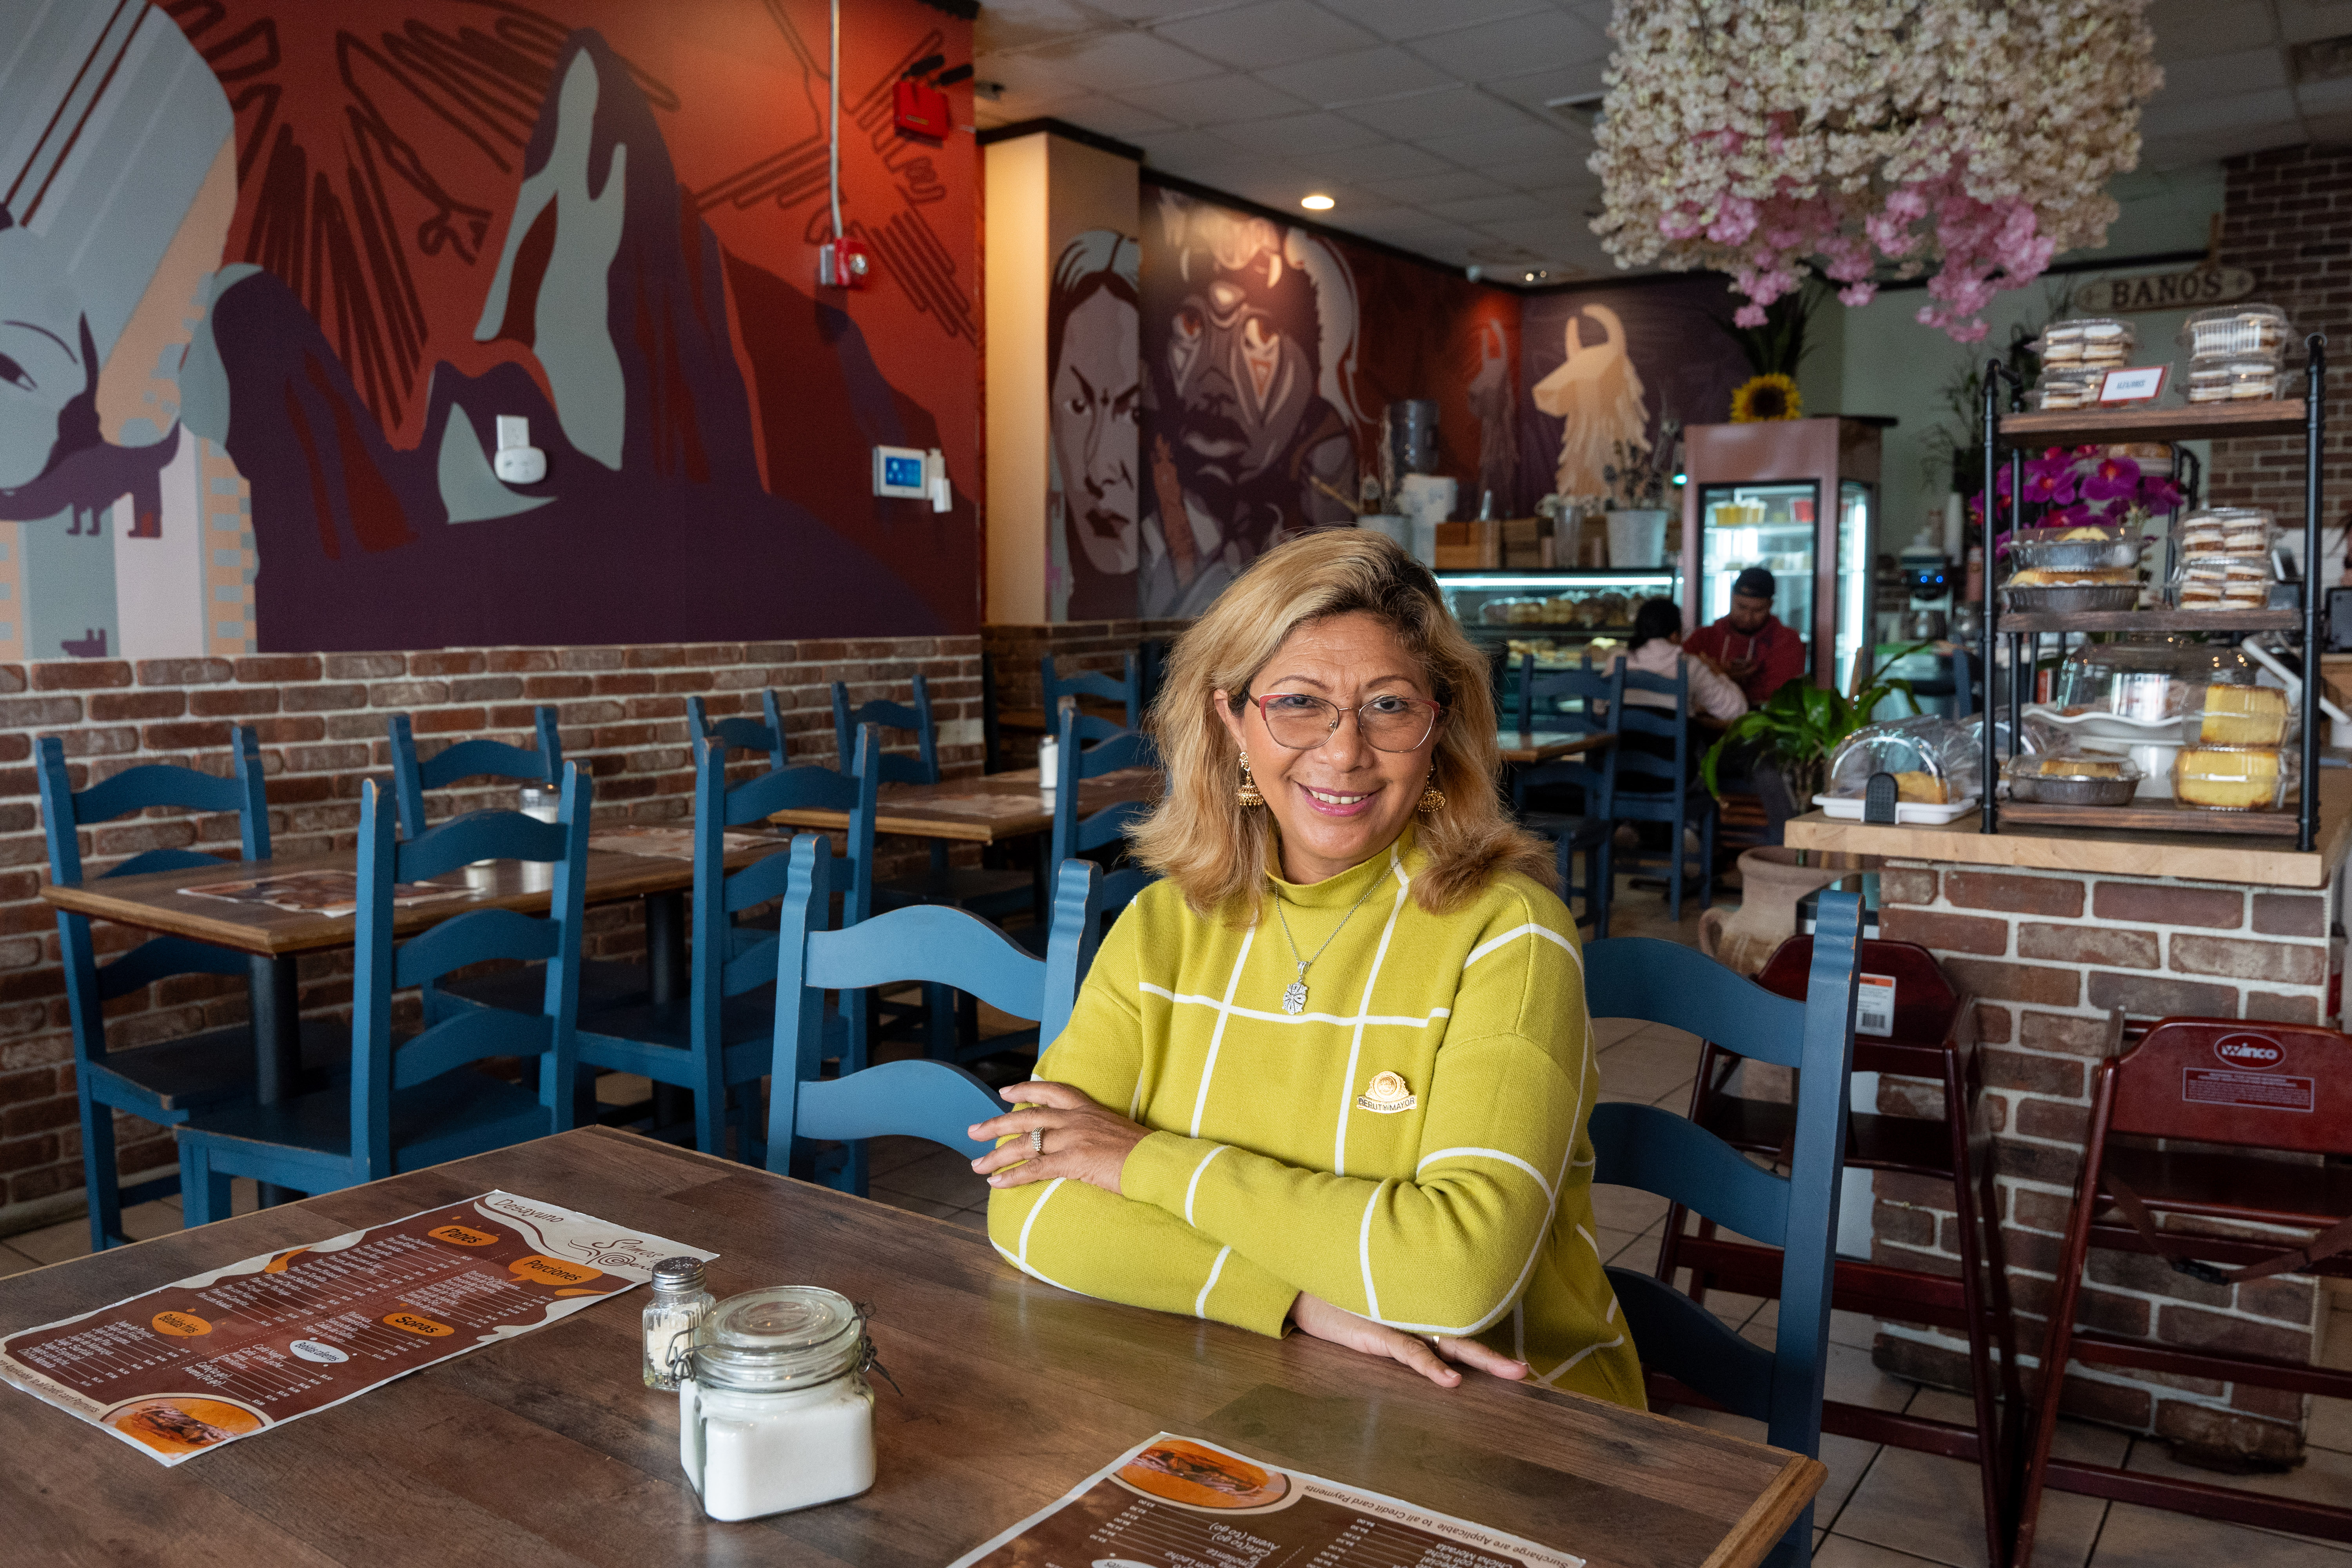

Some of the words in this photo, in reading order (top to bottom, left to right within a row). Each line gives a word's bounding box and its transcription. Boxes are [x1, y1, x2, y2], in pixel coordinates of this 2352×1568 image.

[2221, 1042, 2278, 1060] winco
[1359, 1098, 1387, 1111] DEPUTY
[1390, 1097, 1415, 1111] MAYOR
[494, 1199, 563, 1222] Desayuno
[440, 1228, 482, 1243] Panes
[592, 1239, 664, 1258] Somos
[523, 1259, 581, 1281] Porciones
[158, 1314, 185, 1327] Bebidas
[395, 1316, 438, 1333] Sopas
[55, 1347, 84, 1361] Especial
[69, 1344, 94, 1356] Surtido
[229, 1351, 248, 1361] Avena
[265, 1349, 287, 1359] Negro
[294, 1342, 318, 1352] Bebidas
[314, 1350, 339, 1361] calientes
[33, 1356, 56, 1368] Morada
[217, 1354, 247, 1369] Emoliente
[263, 1357, 283, 1368] Leche
[181, 1366, 206, 1377] Avena
[5, 1364, 33, 1381] Applicable
[42, 1385, 63, 1395] Credit
[69, 1398, 99, 1413] Payments
[1304, 1485, 1350, 1502] Payments
[1350, 1498, 1374, 1508] card
[1375, 1505, 1405, 1519] Credit
[1209, 1522, 1230, 1534] go)
[1227, 1530, 1247, 1540] (to
[1437, 1524, 1491, 1544] Applicable
[1247, 1535, 1280, 1550] Avena
[1436, 1543, 1476, 1560] Morada
[1513, 1547, 1568, 1568] Surcharge
